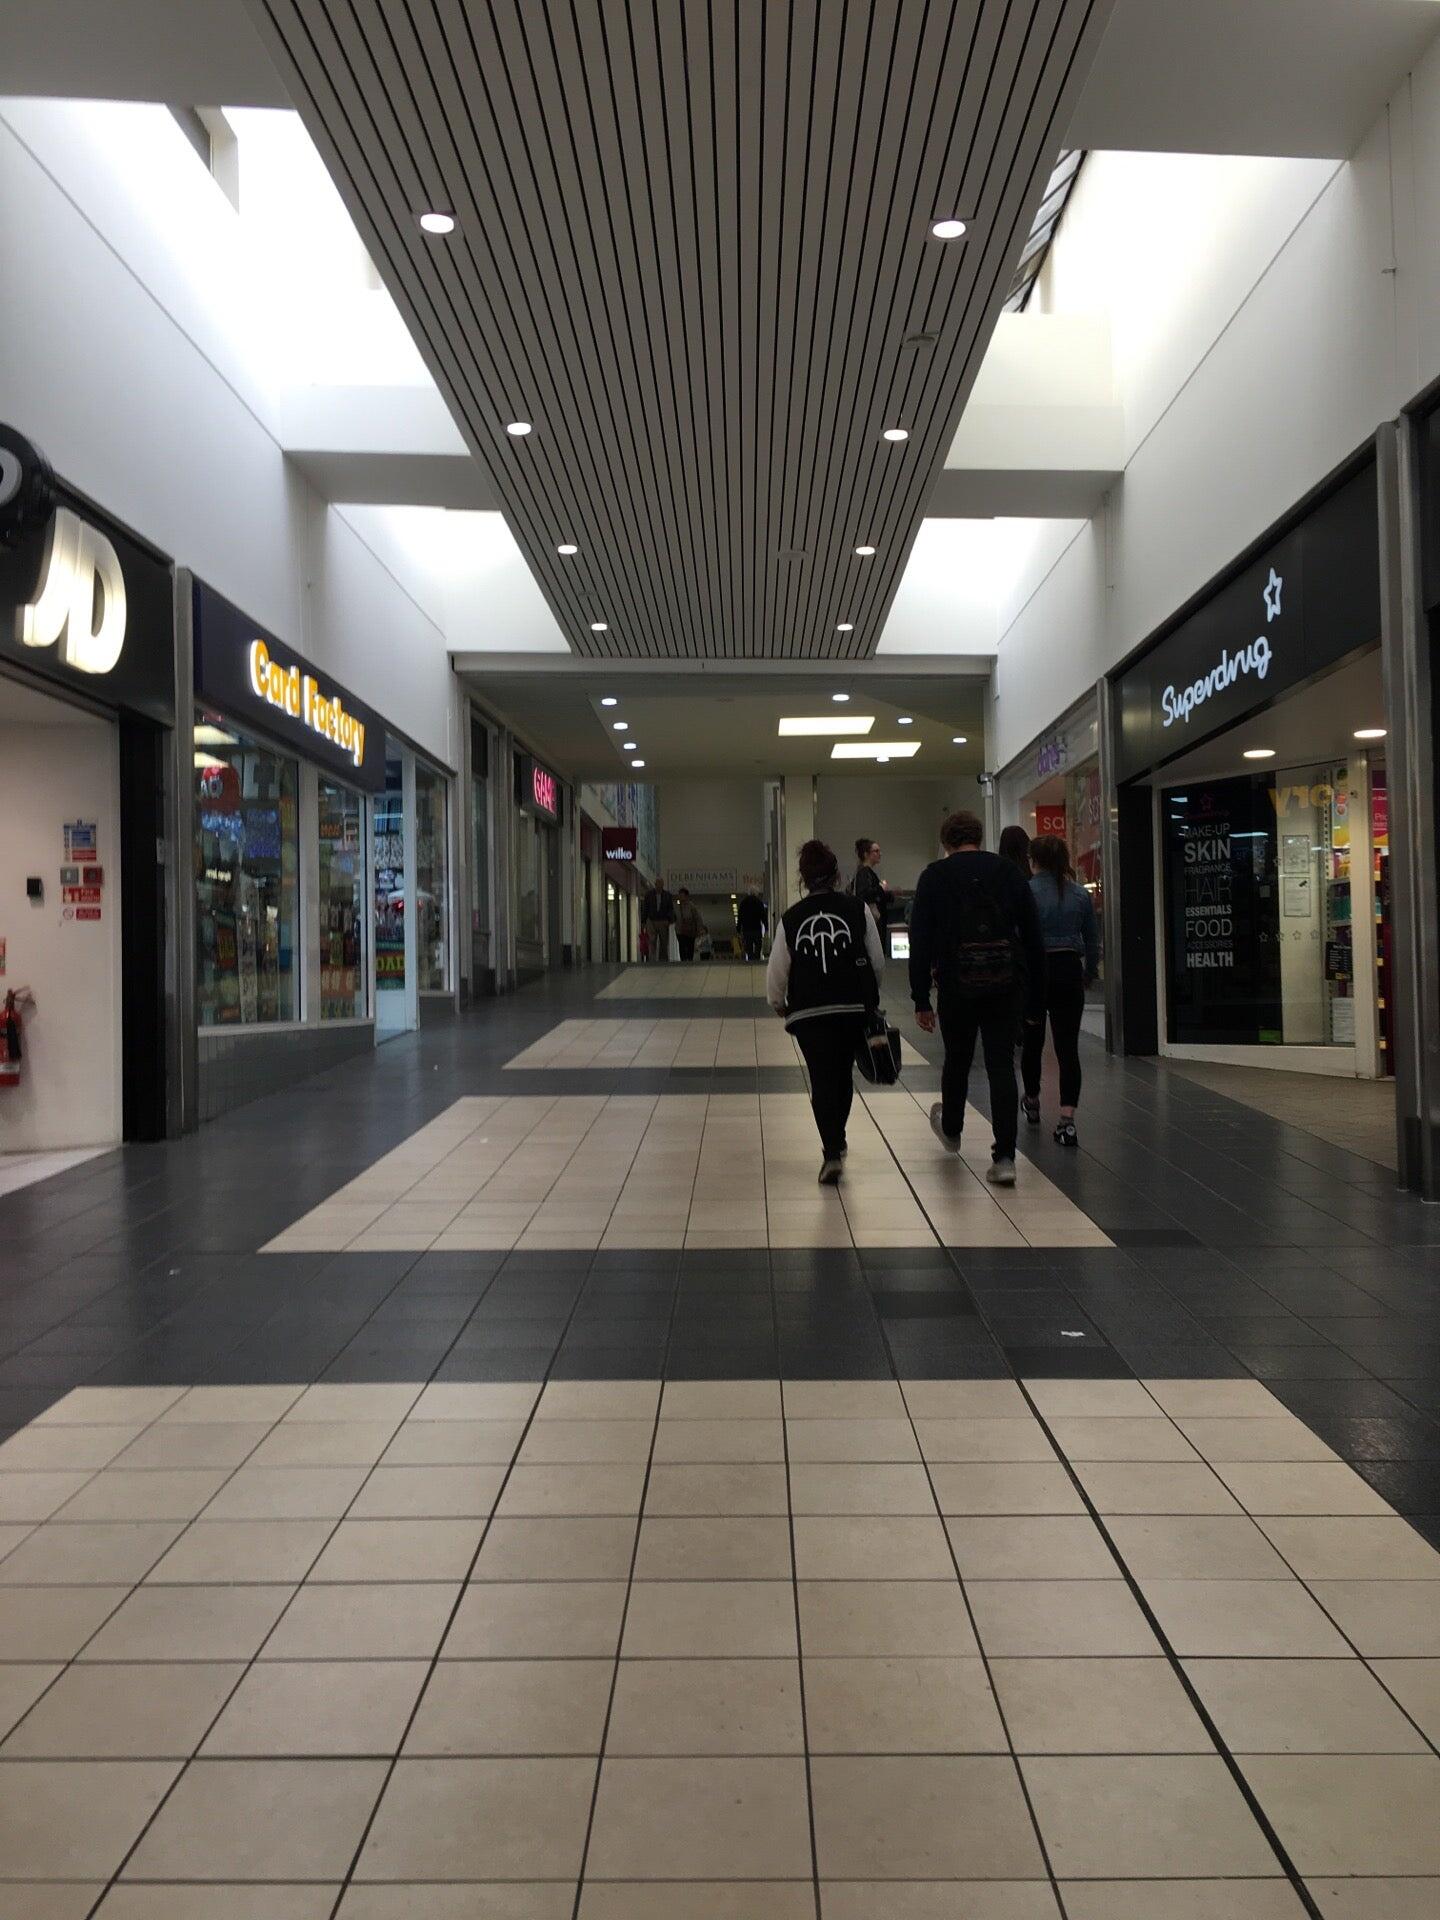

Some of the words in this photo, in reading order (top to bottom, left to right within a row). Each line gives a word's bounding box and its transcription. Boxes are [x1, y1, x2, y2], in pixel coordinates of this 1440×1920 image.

[18, 506, 127, 674] JD
[1162, 636, 1273, 727] Superdrug
[250, 639, 301, 718] Card
[303, 675, 366, 767] Factory
[1185, 823, 1231, 838] MAKE-UP
[606, 847, 632, 859] wilko
[1184, 839, 1231, 863] SKIN
[670, 872, 734, 881] DEBENHAMS
[1185, 877, 1232, 904] HAIR
[1185, 904, 1232, 917] ESSENTIALS
[1185, 918, 1233, 938] FOOD
[1186, 951, 1234, 968] HEALTH
